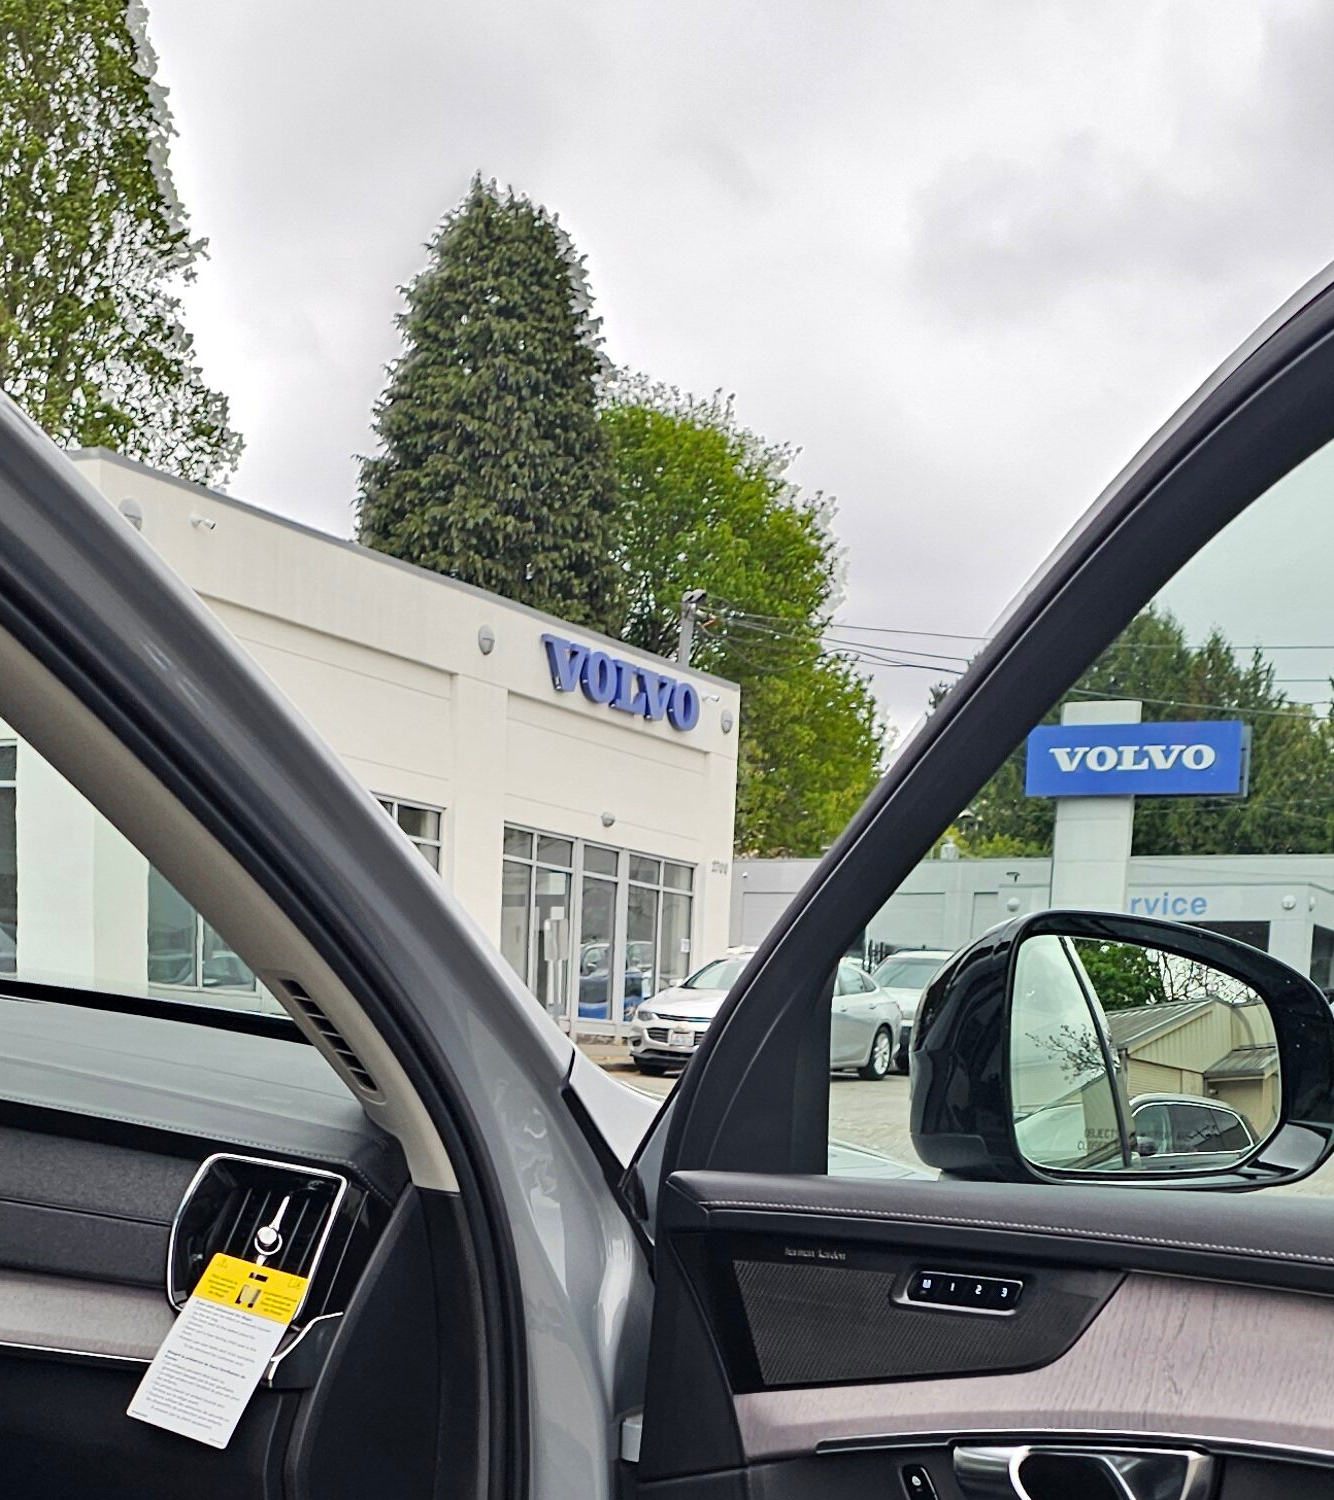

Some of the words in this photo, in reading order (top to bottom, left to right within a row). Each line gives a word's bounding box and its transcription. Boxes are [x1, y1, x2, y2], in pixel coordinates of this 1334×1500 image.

[541, 633, 700, 732] VOLVO
[1049, 744, 1216, 772] VOLVO
[975, 1284, 982, 1295] 2
[1001, 1287, 1008, 1298] 3
